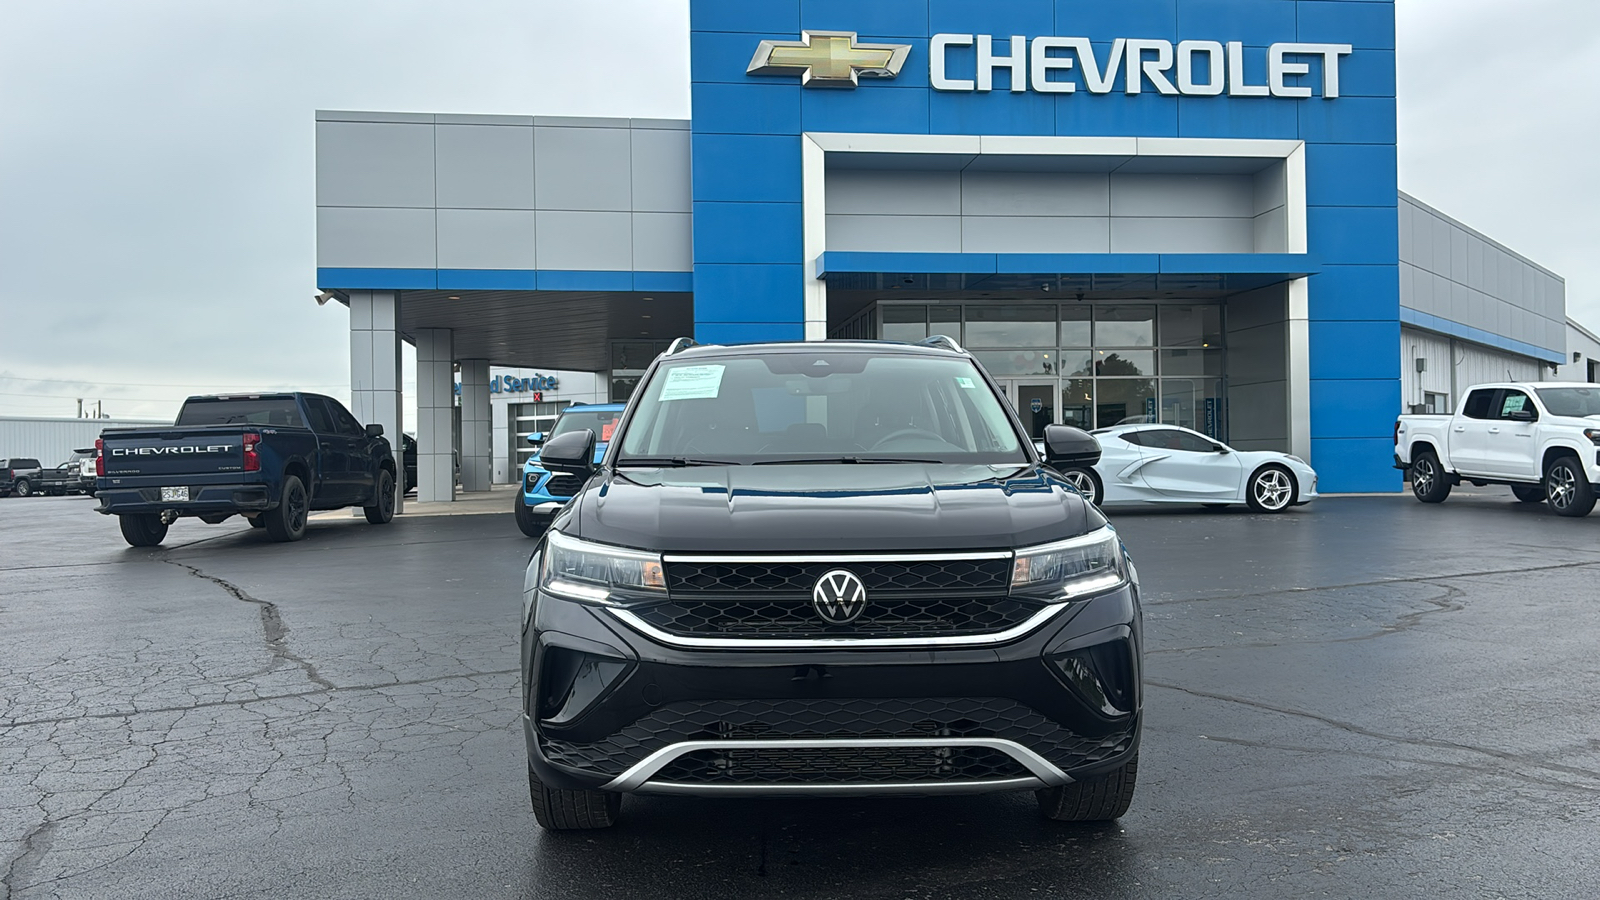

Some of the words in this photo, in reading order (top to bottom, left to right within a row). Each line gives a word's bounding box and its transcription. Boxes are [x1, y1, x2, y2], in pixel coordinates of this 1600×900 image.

[930, 33, 1352, 98] CHEVROLET
[503, 372, 557, 392] Service
[112, 444, 233, 456] CHEVROLET
